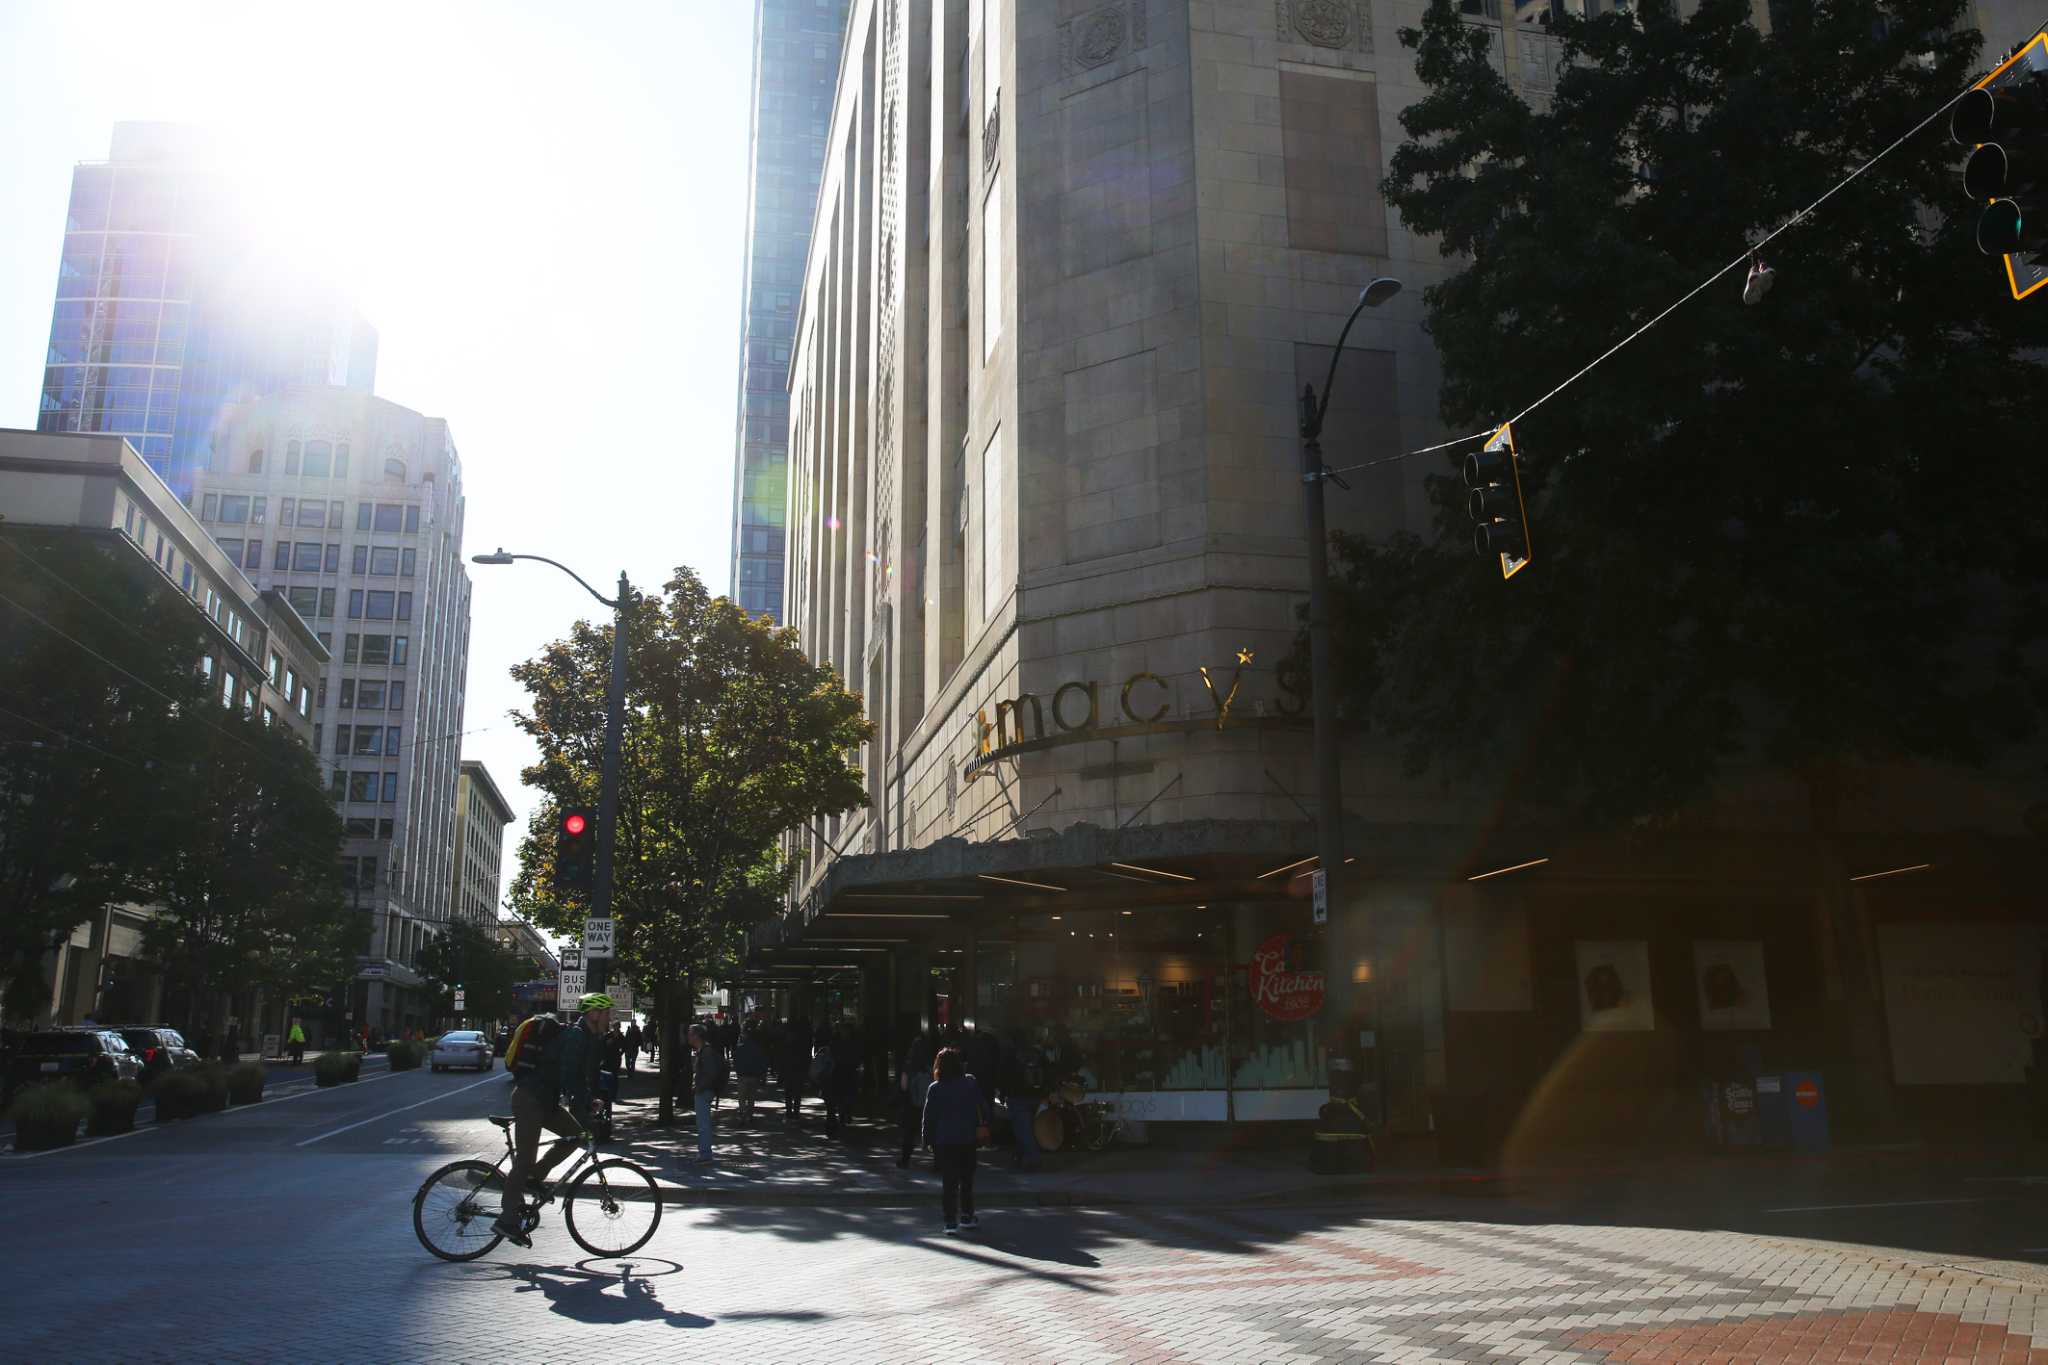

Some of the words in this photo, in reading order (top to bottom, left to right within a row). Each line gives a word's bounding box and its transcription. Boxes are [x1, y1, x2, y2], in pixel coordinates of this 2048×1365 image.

[588, 921, 611, 931] ONE
[587, 932, 610, 942] WAY
[564, 975, 585, 984] BUS
[566, 985, 585, 993] ON
[1256, 974, 1326, 1002] Kitchen
